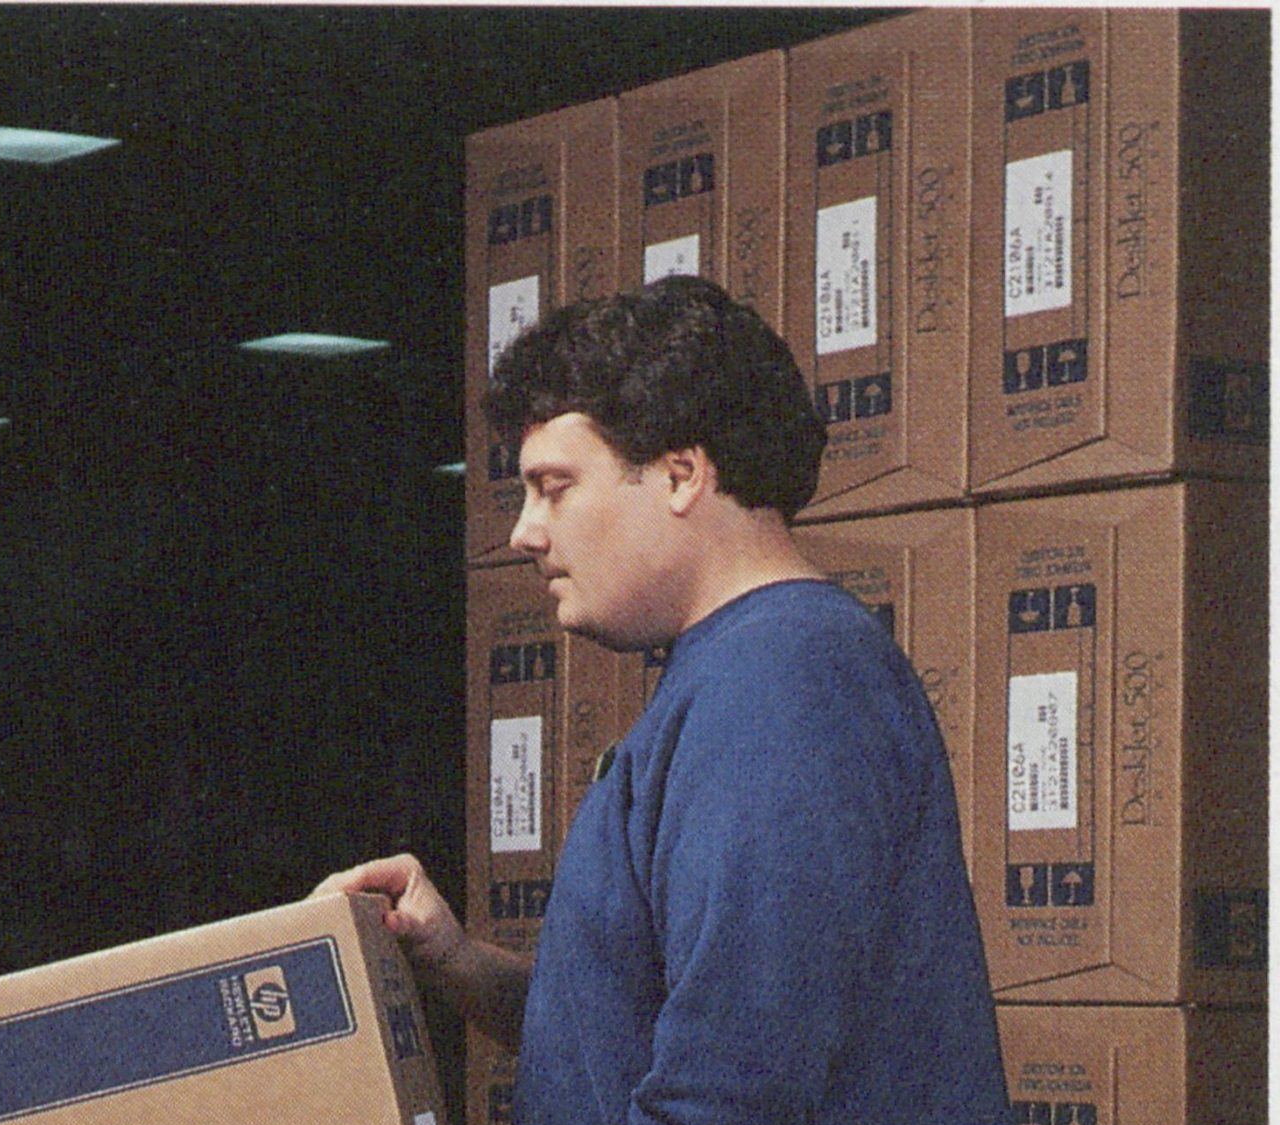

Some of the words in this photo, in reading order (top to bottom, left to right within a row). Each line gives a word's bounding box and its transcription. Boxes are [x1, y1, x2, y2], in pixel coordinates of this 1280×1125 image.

[1119, 119, 1143, 178] 500
[1124, 650, 1149, 706] 500
[1121, 721, 1150, 827] DeskJet
